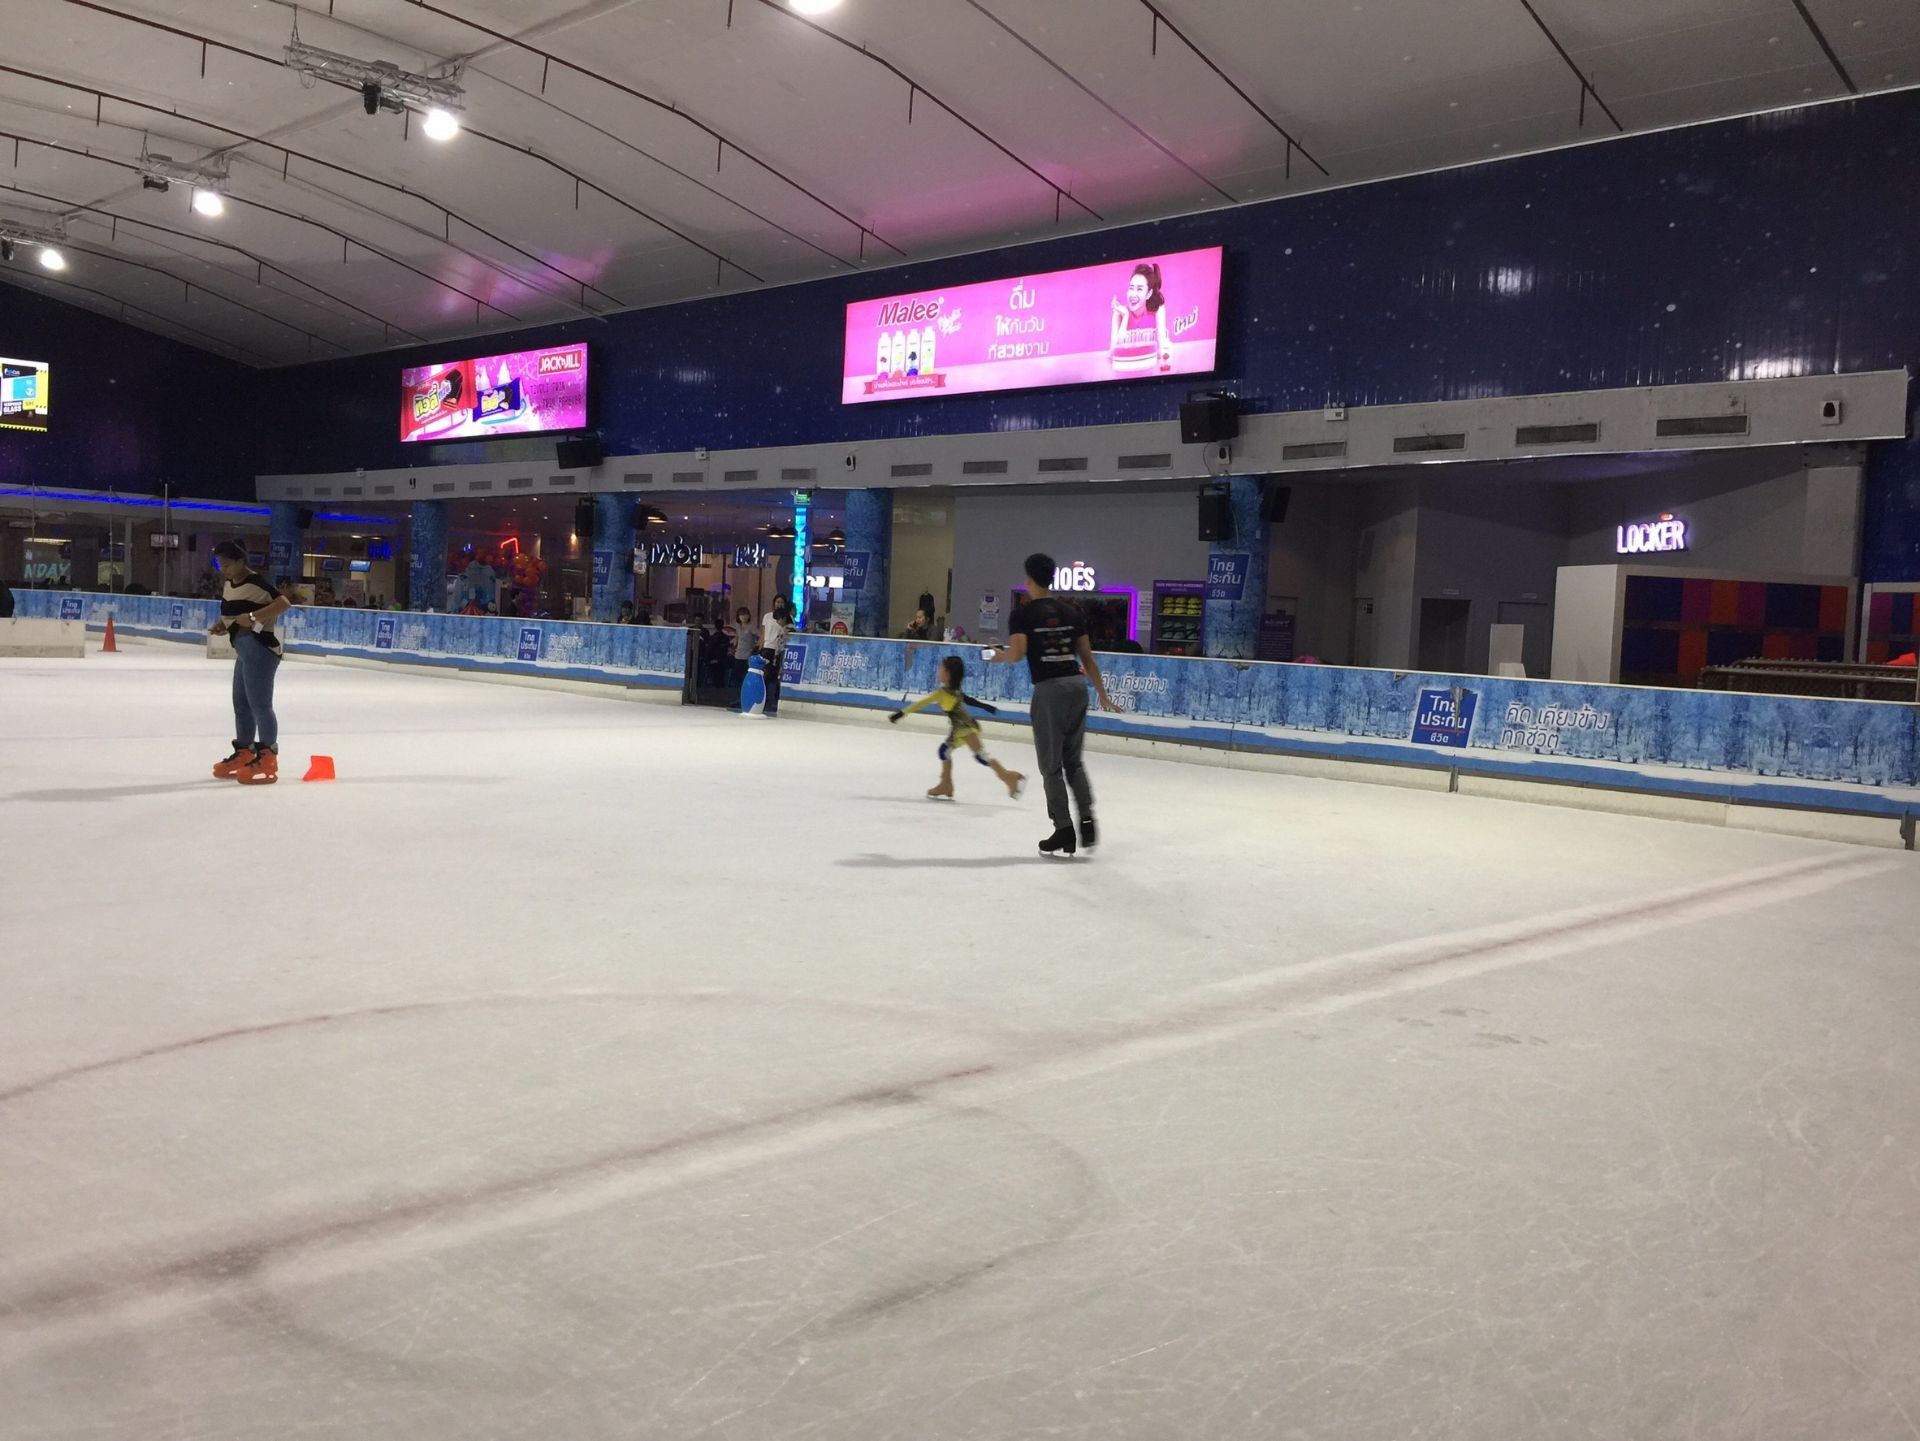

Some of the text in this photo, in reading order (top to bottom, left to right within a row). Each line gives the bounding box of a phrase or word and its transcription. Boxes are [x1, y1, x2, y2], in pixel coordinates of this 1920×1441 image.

[878, 300, 939, 327] Malee
[1616, 520, 1685, 554] LOCKER
[1211, 558, 1235, 572] ไทย
[1047, 566, 1096, 591] HOES
